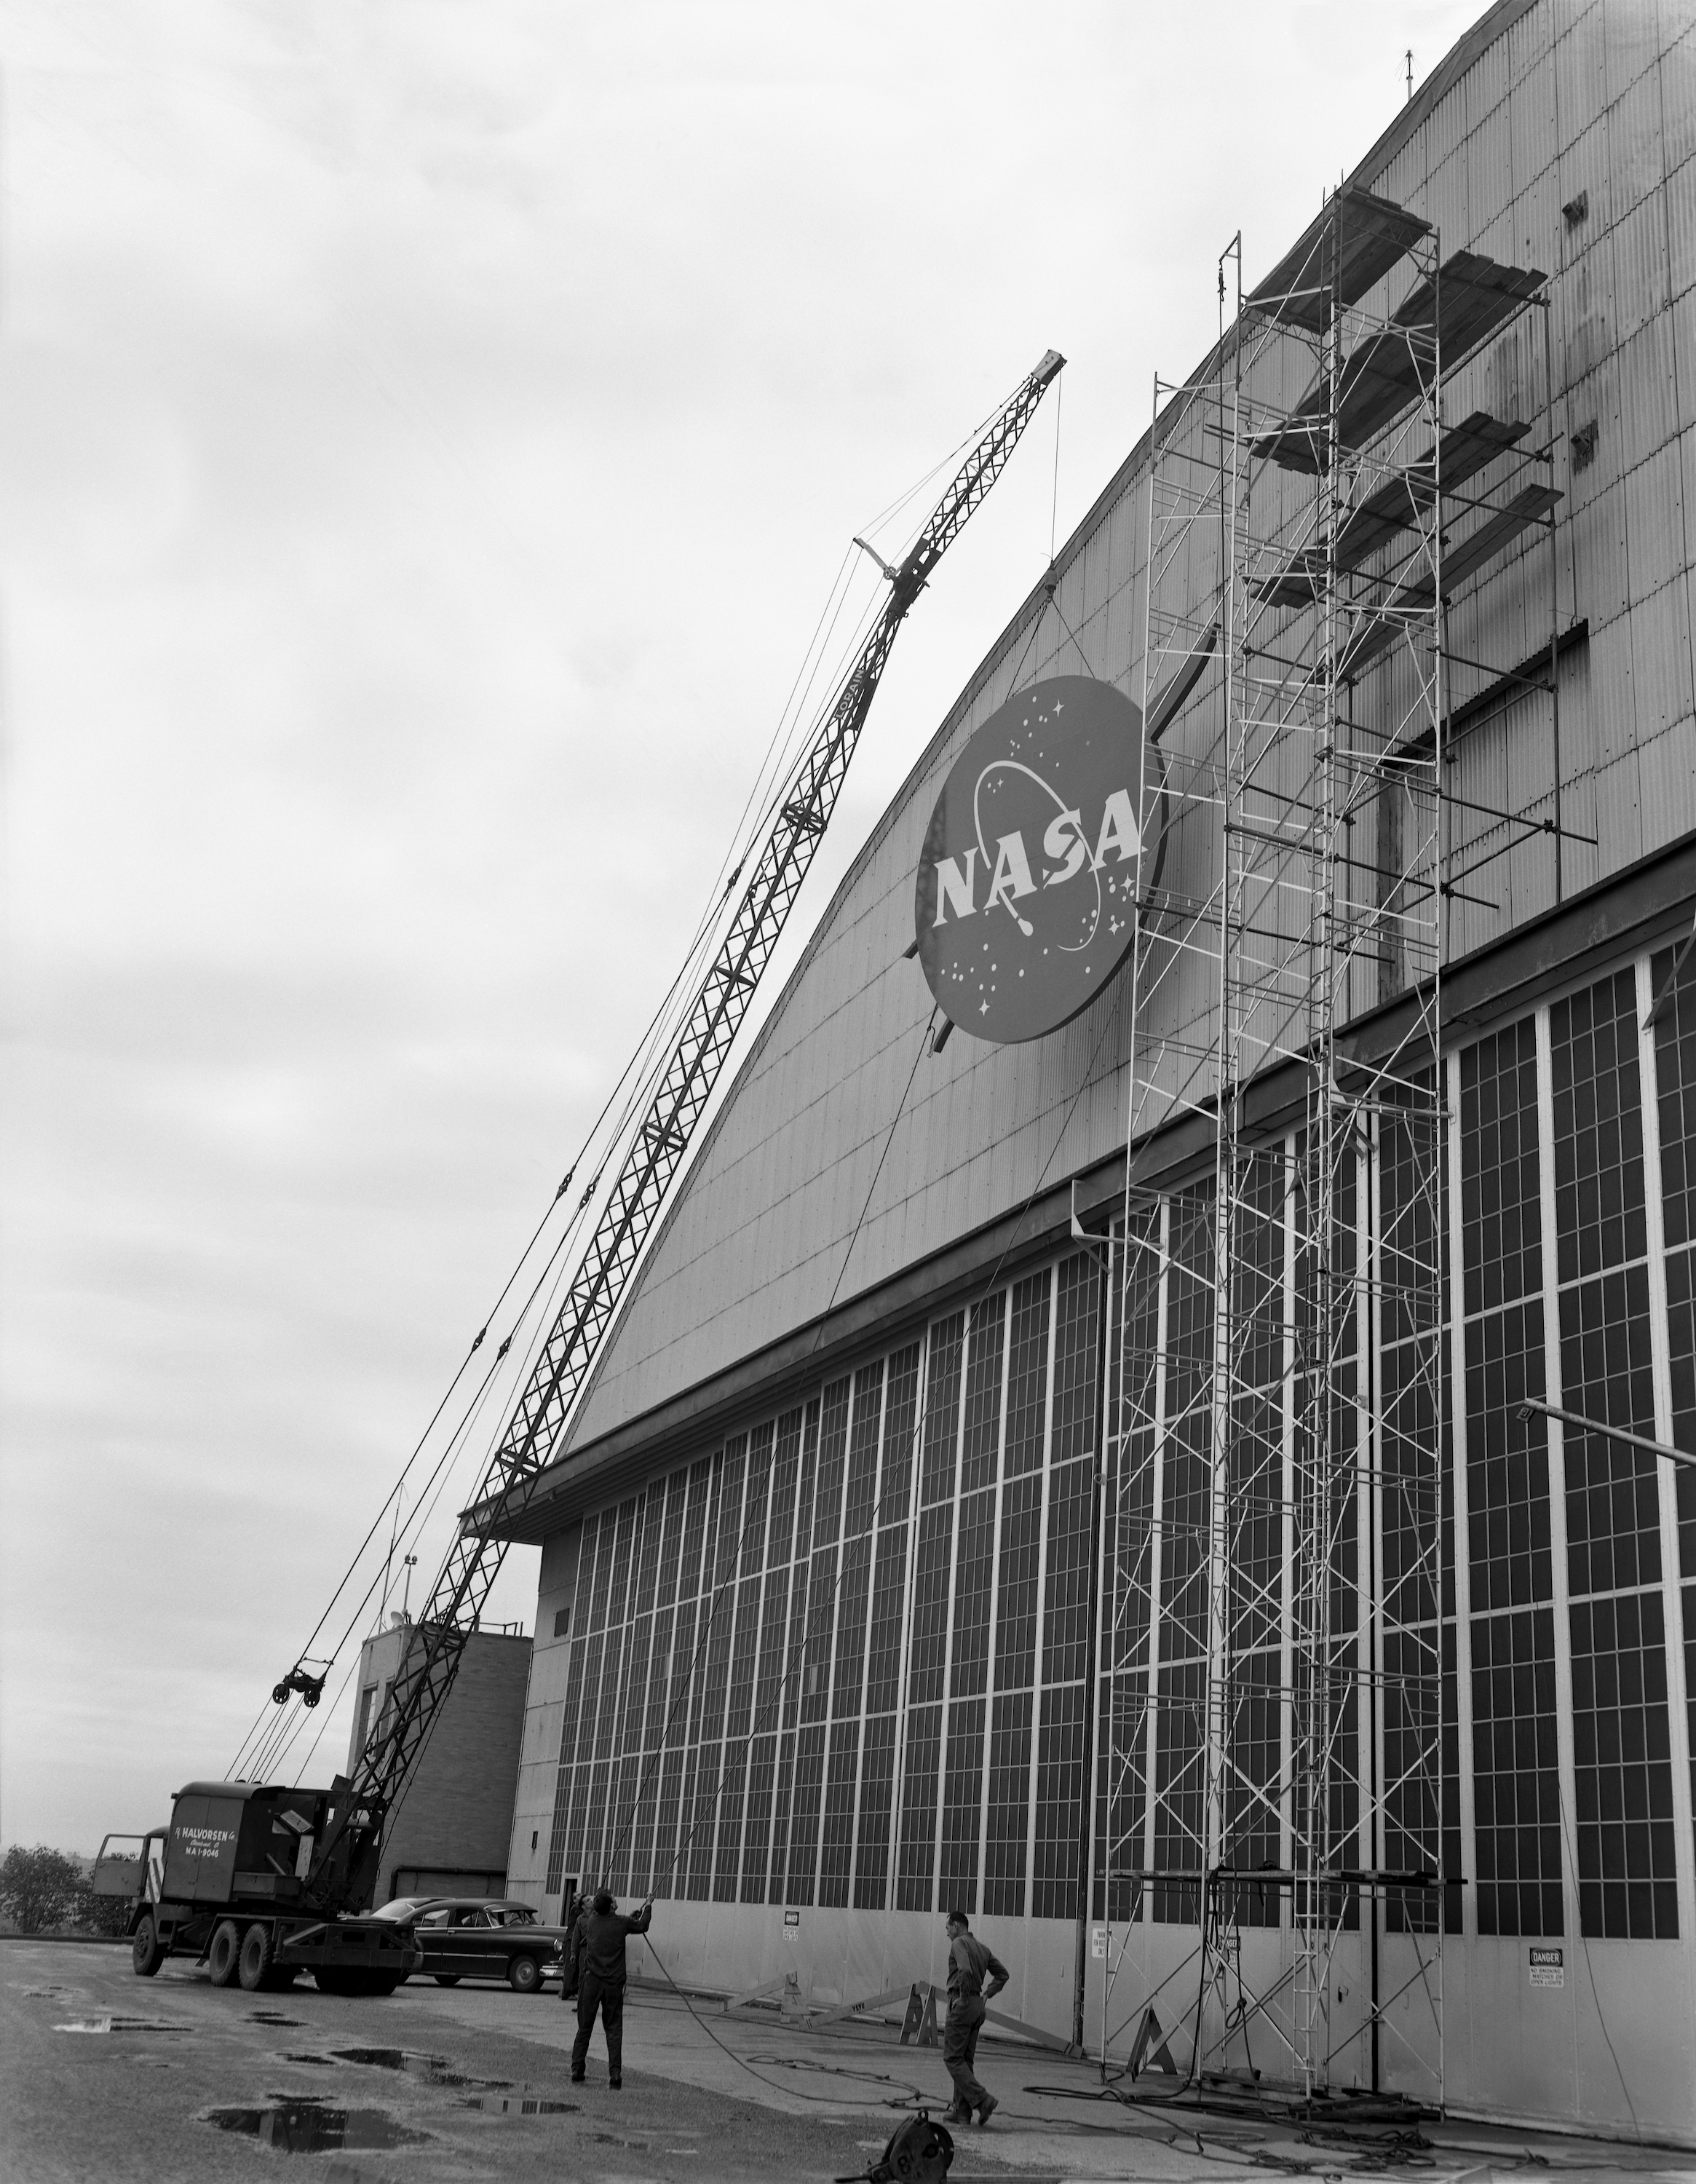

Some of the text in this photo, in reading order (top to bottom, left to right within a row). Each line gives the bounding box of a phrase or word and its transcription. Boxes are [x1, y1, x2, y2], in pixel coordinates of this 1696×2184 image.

[835, 669, 864, 719] LORAIN
[932, 788, 1149, 927] NASA
[182, 1827, 229, 1842] HALVORSEN
[185, 1846, 197, 1856] MA
[1533, 1952, 1560, 1963] DANGER
